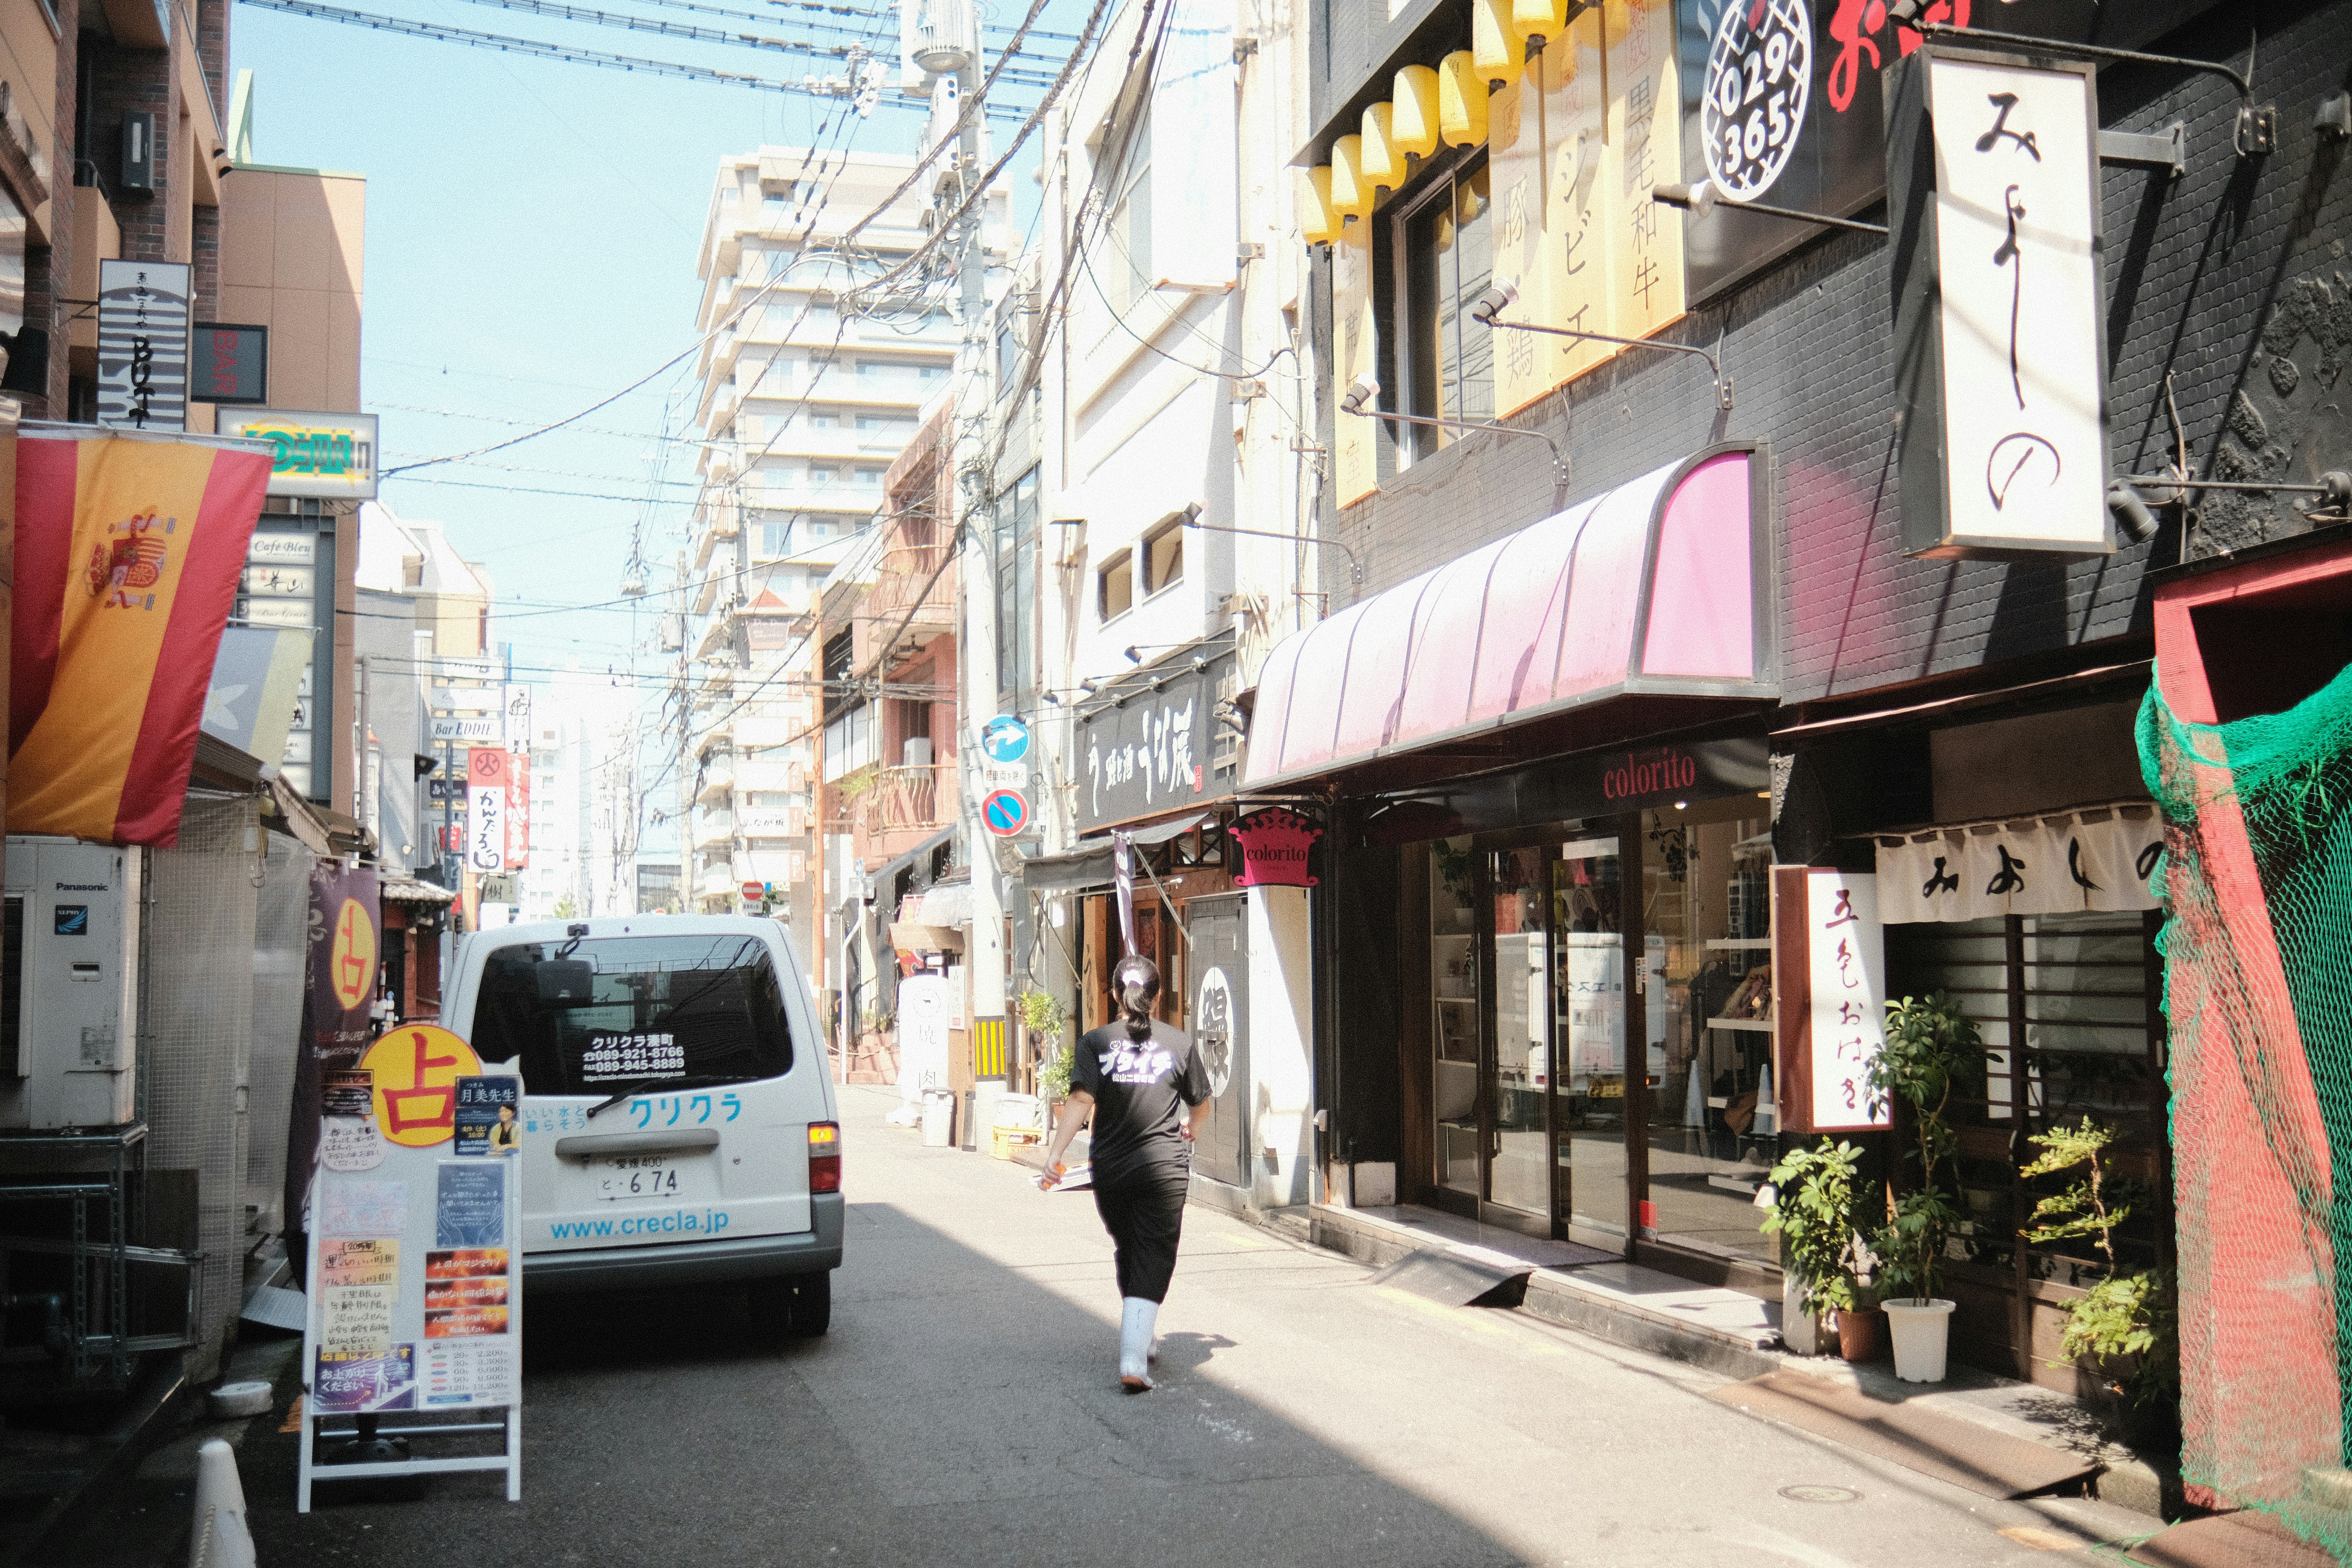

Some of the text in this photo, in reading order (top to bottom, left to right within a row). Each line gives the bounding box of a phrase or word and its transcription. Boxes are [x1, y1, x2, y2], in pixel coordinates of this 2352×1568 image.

[1720, 32, 1788, 116] 029
[1725, 90, 1787, 174] 365
[1629, 76, 1659, 311] 黒毛和牛
[1561, 129, 1595, 354] ジビエ
[1975, 92, 2062, 511] みよしの
[213, 330, 238, 395] BAR
[435, 722, 495, 736] Bar EDDIE
[986, 769, 1025, 782] 軽車両を除く
[1603, 746, 1696, 800] colorito
[1246, 844, 1307, 862] colorito
[56, 882, 109, 891] Panasonic
[487, 882, 503, 900] 樹
[341, 904, 367, 999] 占
[592, 1033, 674, 1051] クリクラ湊町
[1122, 1040, 1158, 1051] ラーメン
[595, 1046, 684, 1062] 089-921-8766
[1098, 1050, 1172, 1076] ブタイチ
[595, 1058, 684, 1073] 089-945-8889
[381, 1031, 458, 1135] 占
[461, 1088, 515, 1103] 月美先生
[524, 1105, 587, 1123] いい水と
[629, 1093, 742, 1128] クリクラ
[525, 1117, 587, 1133] 暮らそう
[615, 1155, 663, 1171] 愛媛 400
[550, 1207, 730, 1240] www.crecla.jp
[321, 1368, 367, 1380] お上がり
[321, 1381, 364, 1392] ください
